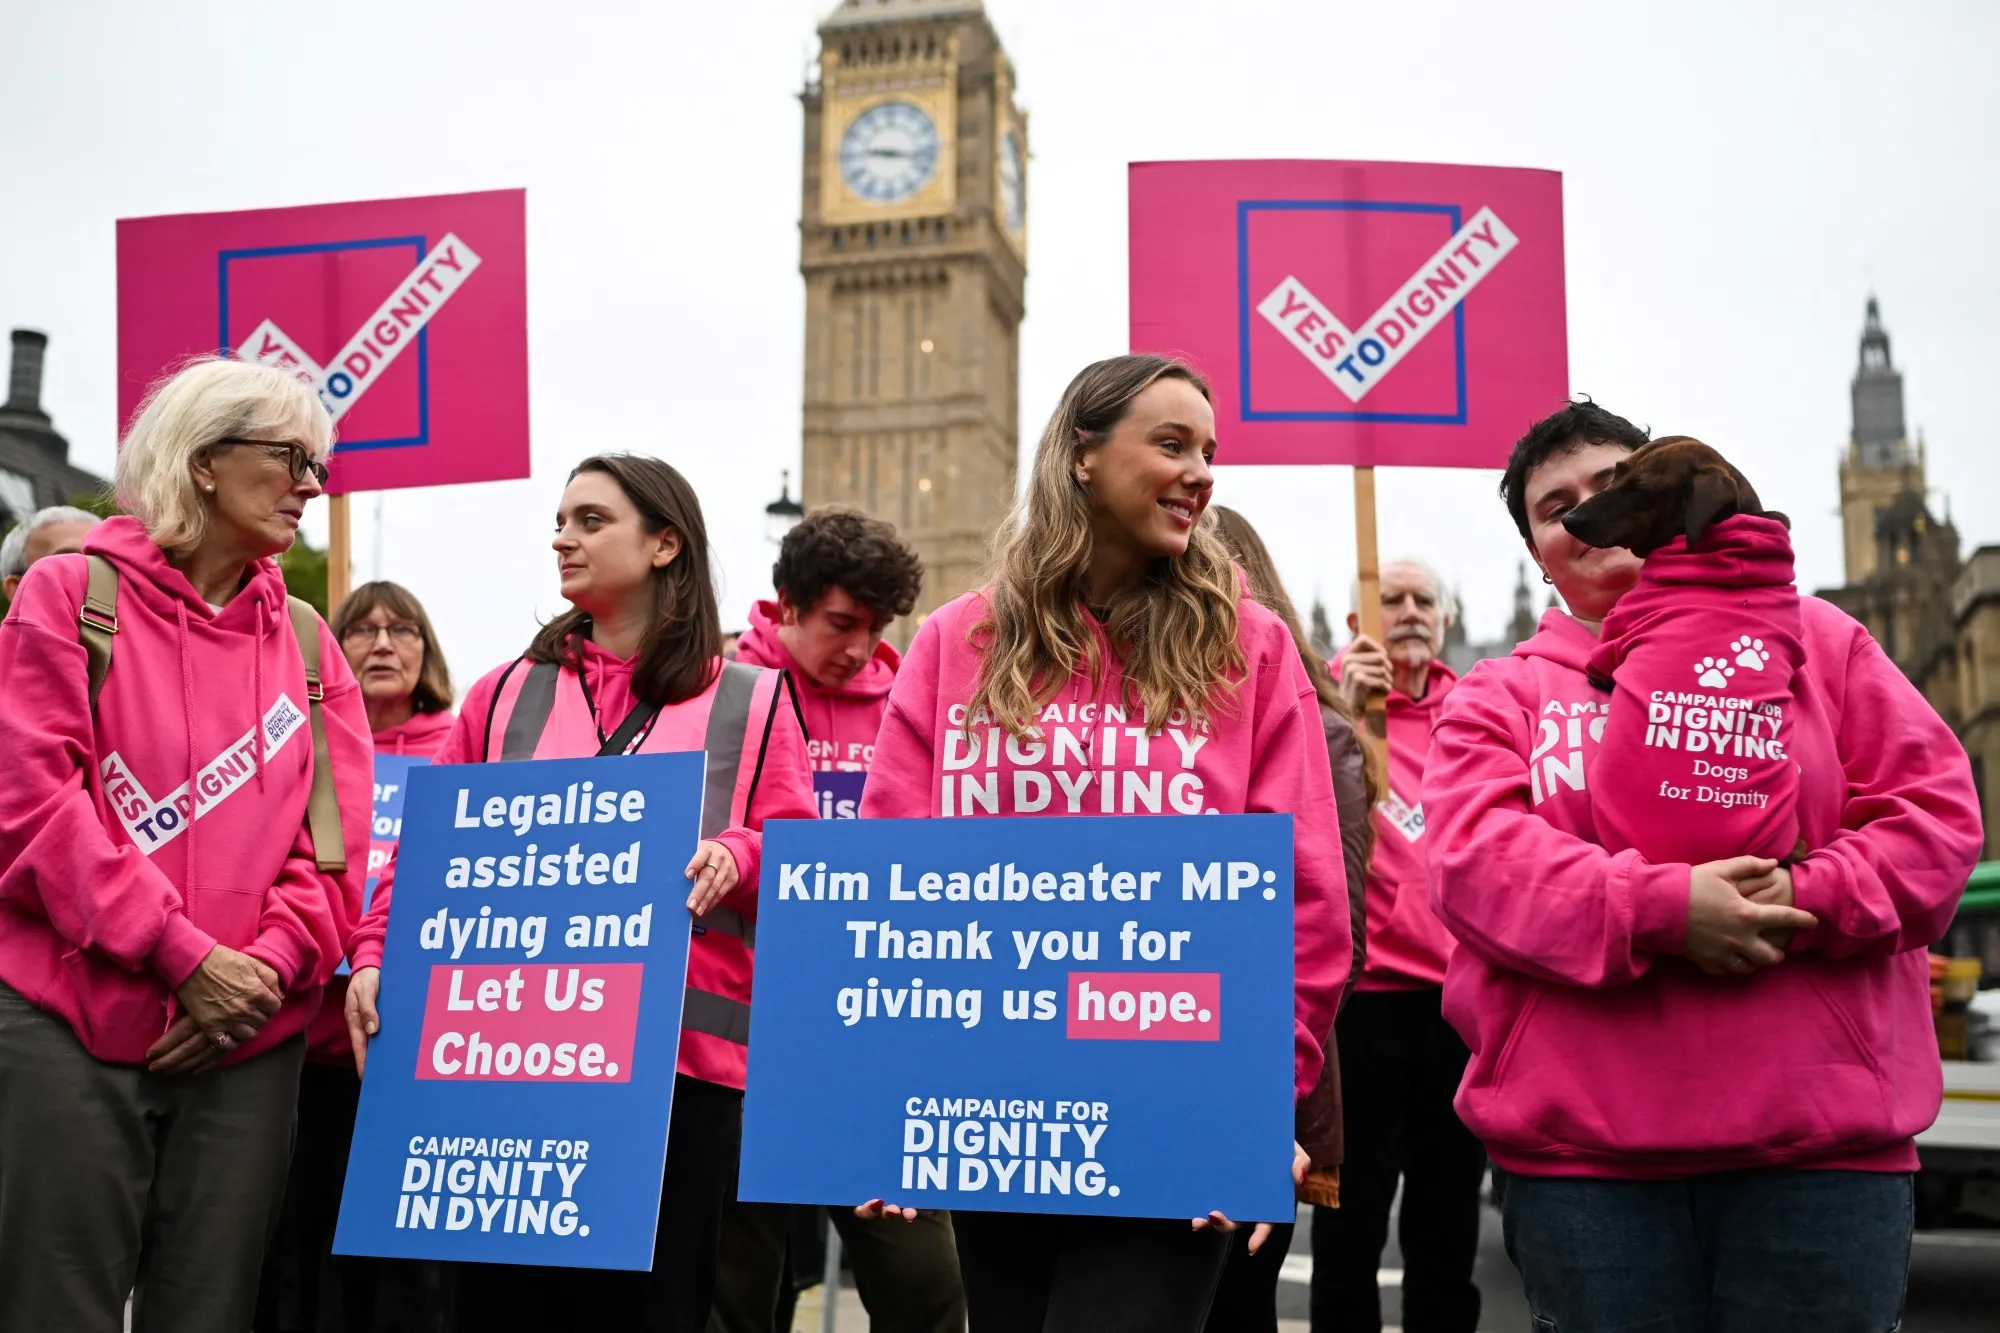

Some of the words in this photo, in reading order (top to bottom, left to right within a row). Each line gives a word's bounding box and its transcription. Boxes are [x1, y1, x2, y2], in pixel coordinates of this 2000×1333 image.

[1276, 289, 1346, 360] YES
[1374, 219, 1500, 351] DIGNITY
[343, 244, 464, 380] DIGNITY
[267, 705, 291, 735] DIGNITY
[1648, 702, 1783, 740] DIGNITY
[1651, 690, 1753, 711] CAMPAIGN
[1757, 701, 1783, 719] FOR
[272, 731, 281, 742] IN
[279, 713, 300, 735] DYING.
[942, 726, 1209, 771] DIGNITY
[1645, 724, 1681, 749] IN
[1685, 729, 1788, 761] DYING.
[103, 760, 148, 821] YES
[1530, 750, 1586, 807] IN
[1692, 759, 1748, 783] Dogs
[454, 780, 645, 836] Legalise
[941, 771, 1000, 817] IN
[1658, 781, 1691, 800] for
[1695, 785, 1769, 809] Dignity
[445, 840, 641, 888] assisted
[778, 862, 869, 901] Kim
[889, 861, 1161, 902] Leadbeater
[1182, 861, 1277, 902] MP:
[419, 905, 547, 960] dying
[564, 903, 653, 948] and
[846, 920, 993, 960] Thank
[1011, 929, 1099, 970] you
[1120, 920, 1191, 961] for
[447, 968, 525, 1012] Let
[543, 968, 606, 1012] Us
[836, 977, 982, 1029] giving
[1002, 987, 1057, 1021] us
[1077, 980, 1212, 1032] hope.
[431, 1031, 620, 1078] Choose.
[905, 1096, 1044, 1120] CAMPAIGN
[1055, 1100, 1109, 1122] FOR
[408, 1135, 532, 1159] CAMPAIGN
[540, 1139, 590, 1161] FOR
[903, 1118, 1109, 1159] DIGNITY
[401, 1157, 587, 1198] DIGNITY
[901, 1155, 948, 1191] IN
[958, 1157, 1121, 1198] DYING.
[395, 1194, 440, 1230] IN
[445, 1196, 590, 1238] DYING.
